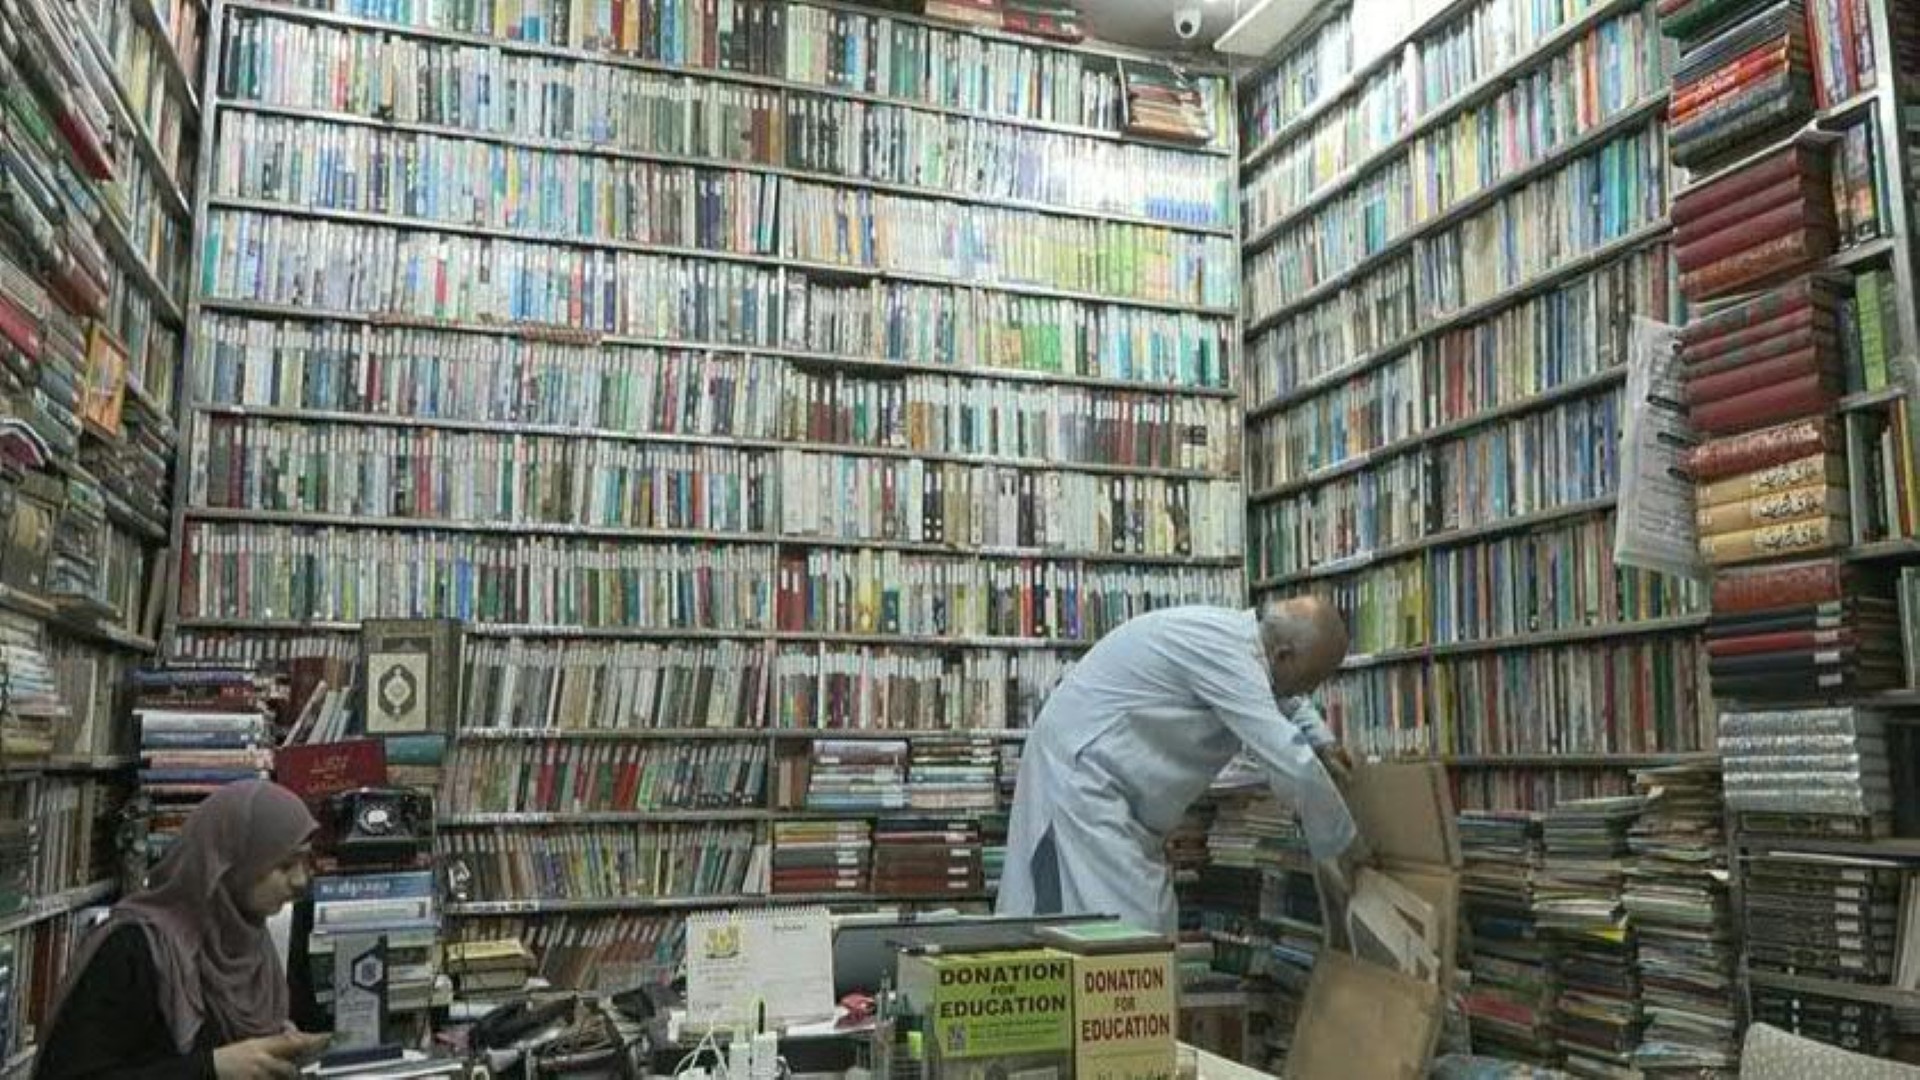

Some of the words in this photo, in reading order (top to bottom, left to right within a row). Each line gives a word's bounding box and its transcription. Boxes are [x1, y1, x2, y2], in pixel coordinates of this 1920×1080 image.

[940, 963, 1066, 986] DONATION
[1084, 966, 1163, 993] DONATION
[940, 995, 1066, 1018] EDUCATION
[1081, 1014, 1170, 1041] EDUCATION
